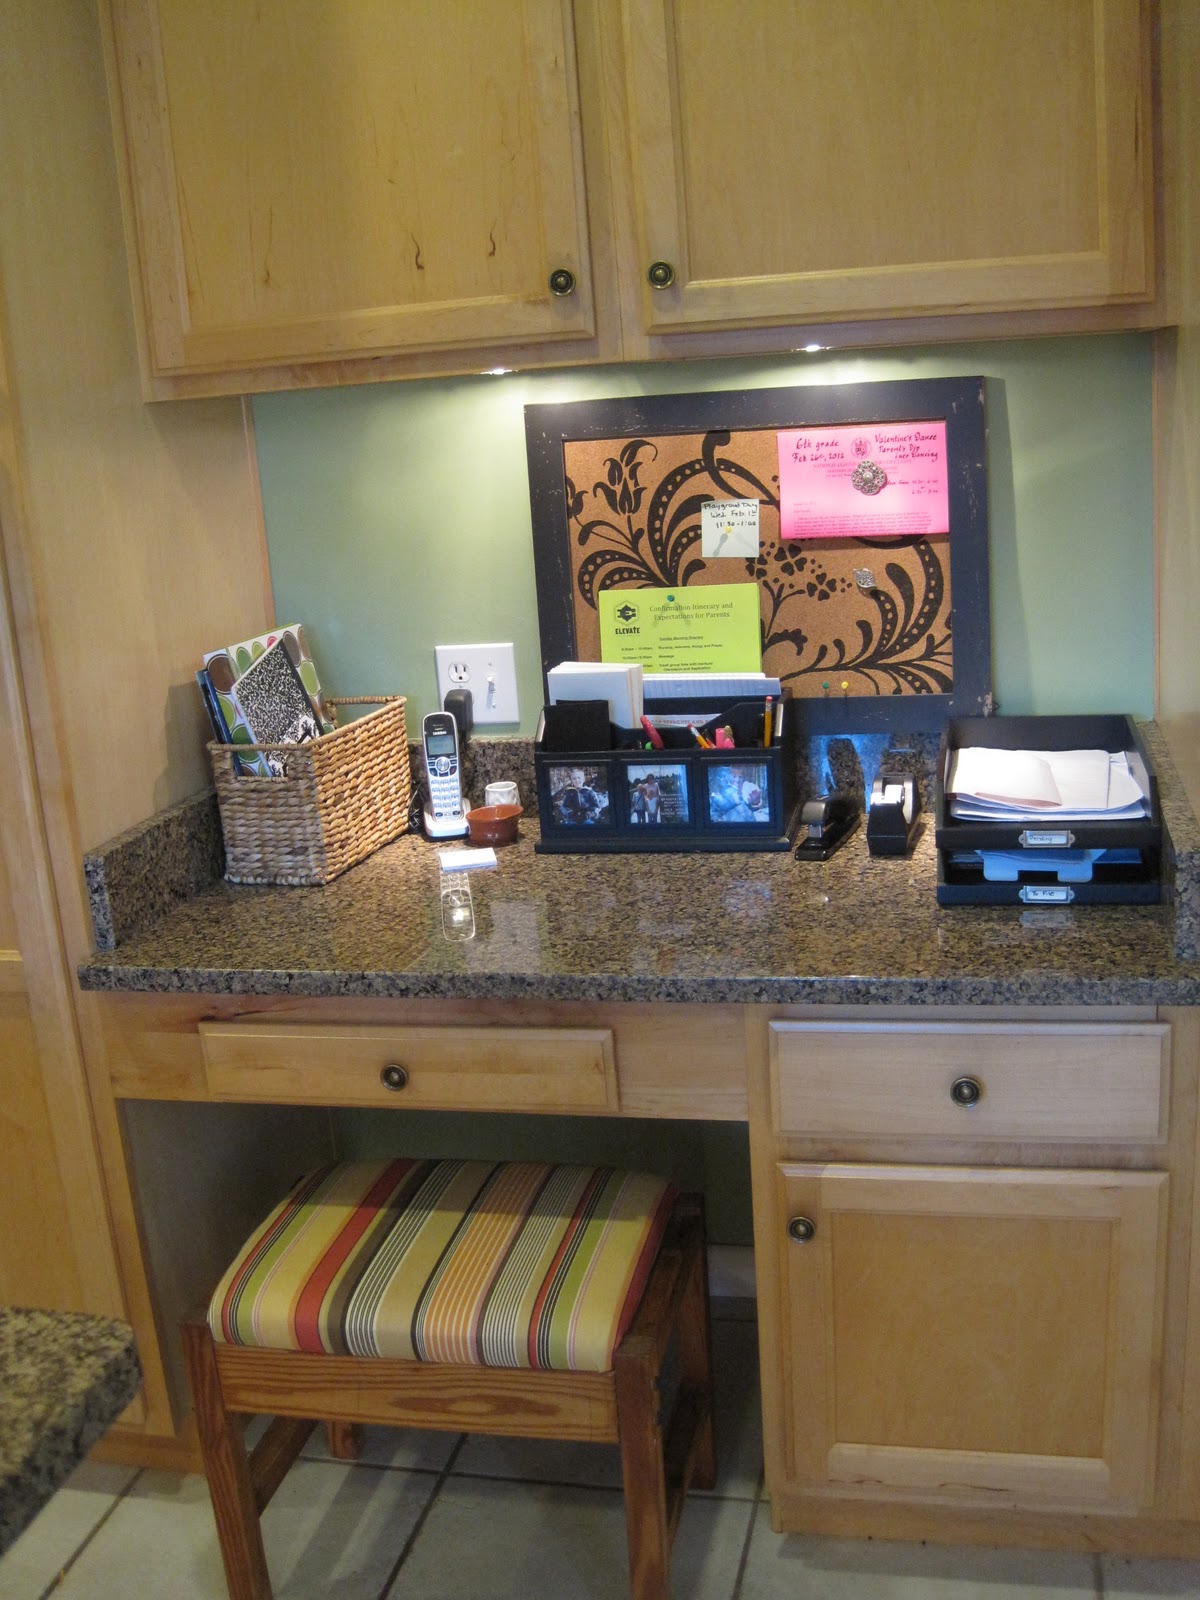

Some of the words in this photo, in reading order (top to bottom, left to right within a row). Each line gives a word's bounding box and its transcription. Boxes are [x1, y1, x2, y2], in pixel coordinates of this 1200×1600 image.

[874, 433, 912, 443] Valentine's
[914, 431, 937, 441] Dance
[796, 437, 811, 449] 6th
[815, 439, 839, 451] grade
[828, 452, 845, 460] 2012
[649, 604, 691, 612] Confirmation
[653, 613, 694, 621] Expectations
[615, 626, 641, 635] ELEVATE
